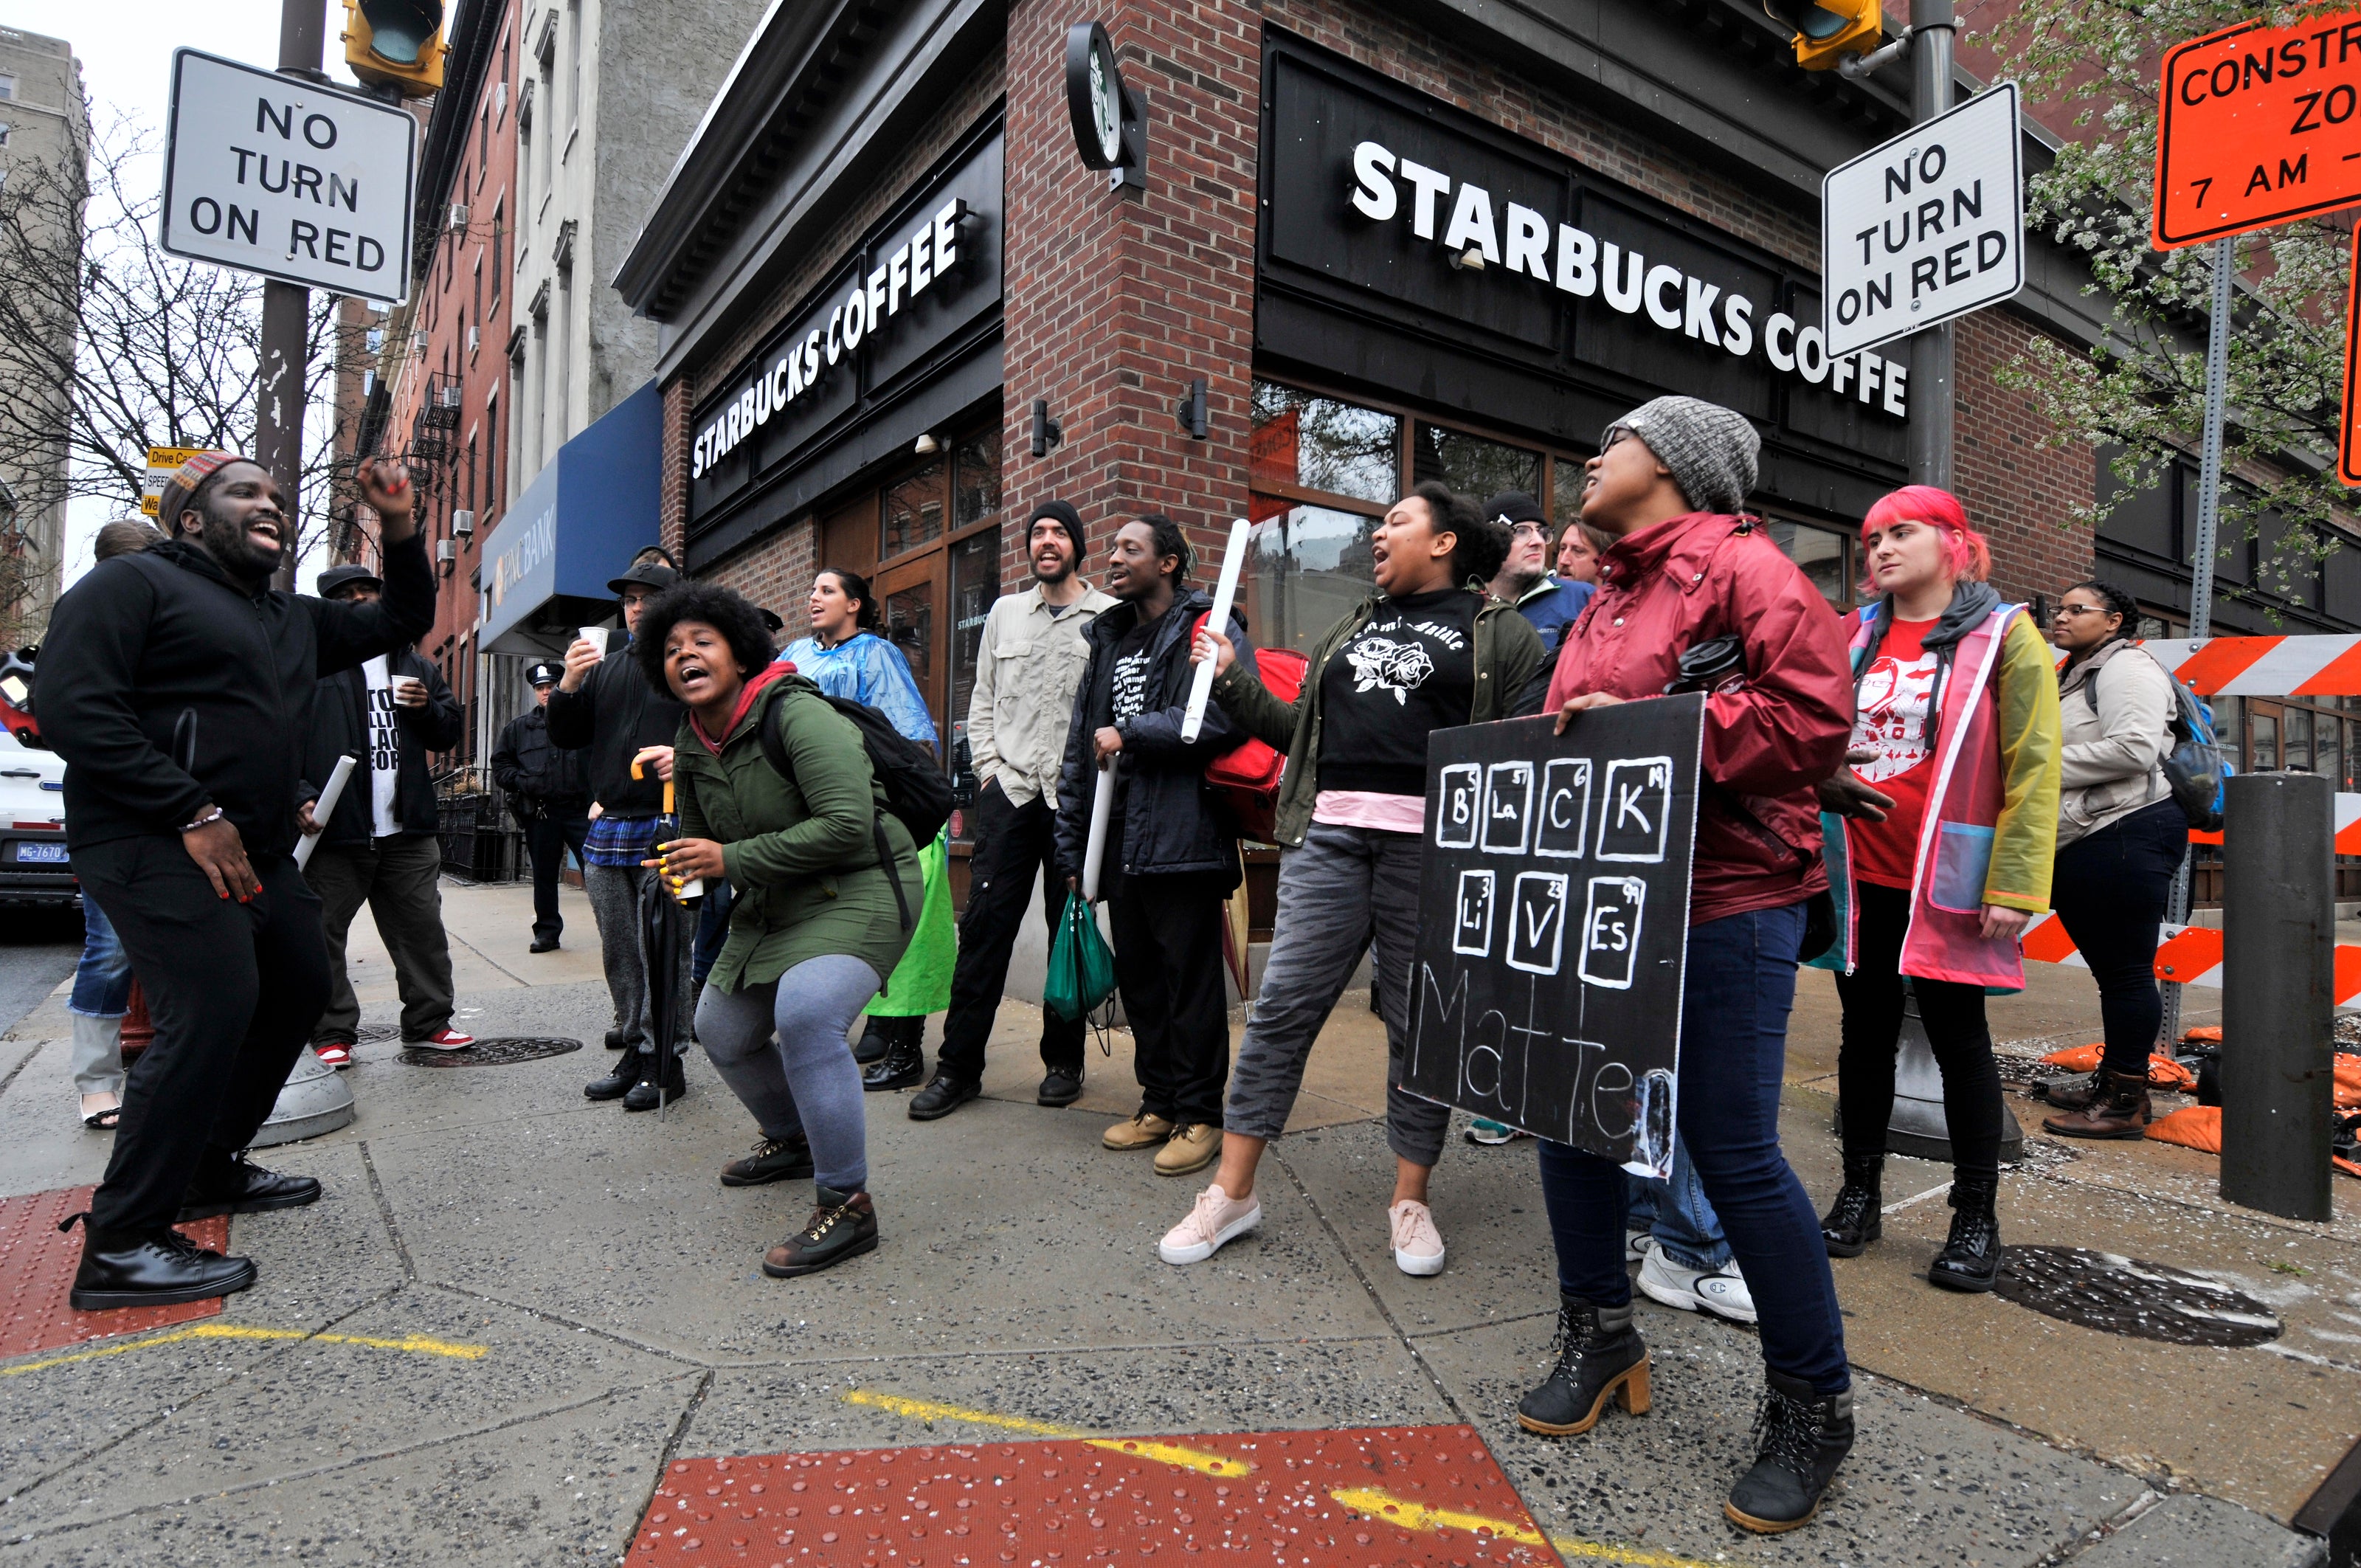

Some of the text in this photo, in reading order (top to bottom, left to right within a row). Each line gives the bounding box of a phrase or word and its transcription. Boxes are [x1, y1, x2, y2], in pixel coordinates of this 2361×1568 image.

[257, 97, 337, 150] NO
[2290, 84, 2361, 135] ZO
[229, 146, 358, 213] TURN
[1885, 144, 1946, 204] NO
[2190, 177, 2213, 209] 7
[2244, 153, 2307, 198] AM
[190, 196, 384, 272] ON RED
[1352, 141, 1753, 356] STARBUCKS
[1856, 179, 1982, 266] TURN
[1836, 230, 2007, 326] ON RED
[693, 196, 957, 479] STARBUCKS COFFEE
[152, 451, 174, 464] Drive
[504, 503, 554, 593] PNC BANK
[958, 614, 989, 630] STARBUC
[1468, 770, 1476, 792] 5
[1574, 765, 1586, 787] 6
[1453, 783, 1652, 834] B La C K
[21, 846, 65, 857] MG-7670
[1482, 877, 1490, 898] 3
[1547, 881, 1563, 899] 23
[1463, 898, 1482, 930] Li
[1525, 900, 1556, 947] V
